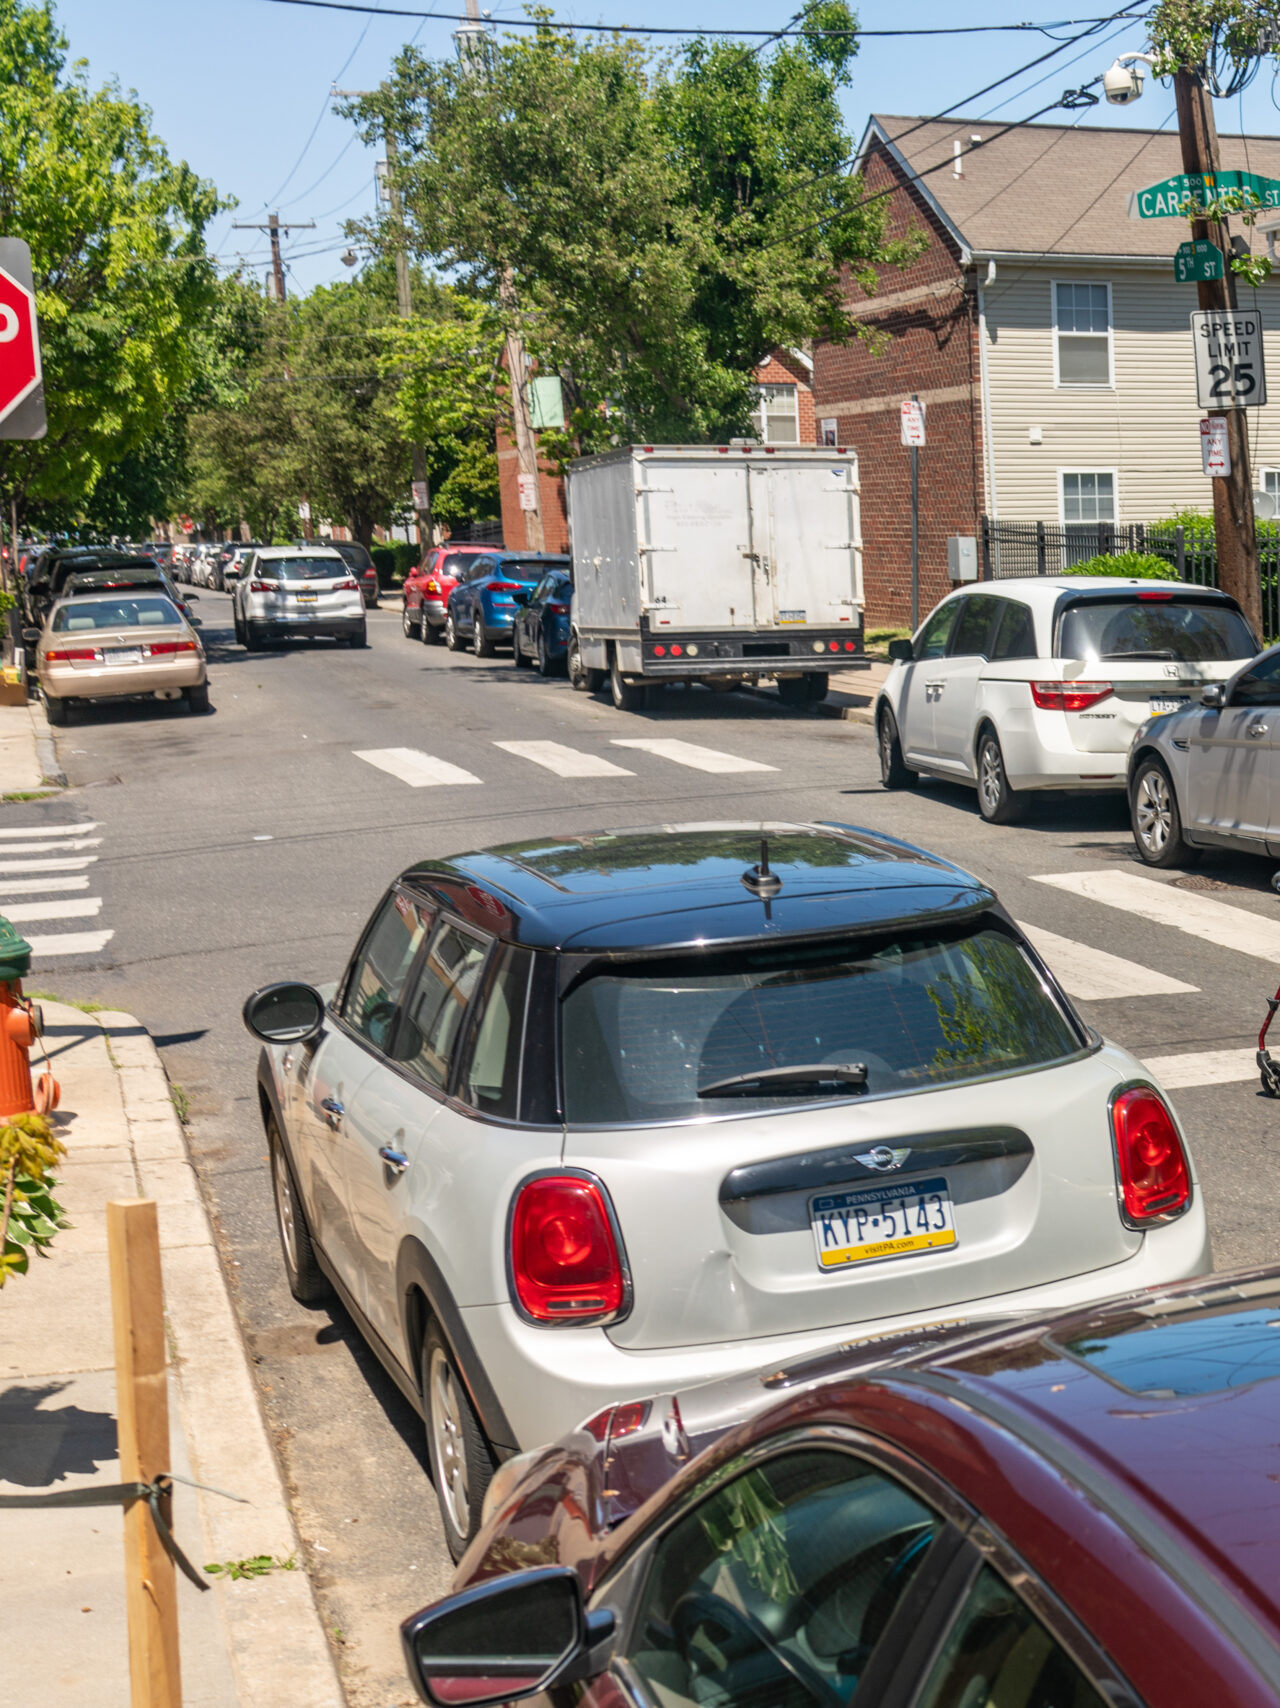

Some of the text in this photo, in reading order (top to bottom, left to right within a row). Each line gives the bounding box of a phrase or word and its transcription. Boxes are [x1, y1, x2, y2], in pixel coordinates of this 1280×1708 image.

[1183, 175, 1214, 187] 500 W
[1264, 189, 1279, 206] ST
[1203, 261, 1216, 277] ST
[1200, 321, 1256, 338] SPEED
[1208, 342, 1251, 358] LIMIT
[1208, 363, 1256, 398] 25
[1207, 438, 1222, 446] ANY
[1208, 449, 1225, 457] TIME
[845, 1185, 917, 1205] PENNSYLVANIA
[864, 1239, 915, 1255] visitPA.com
